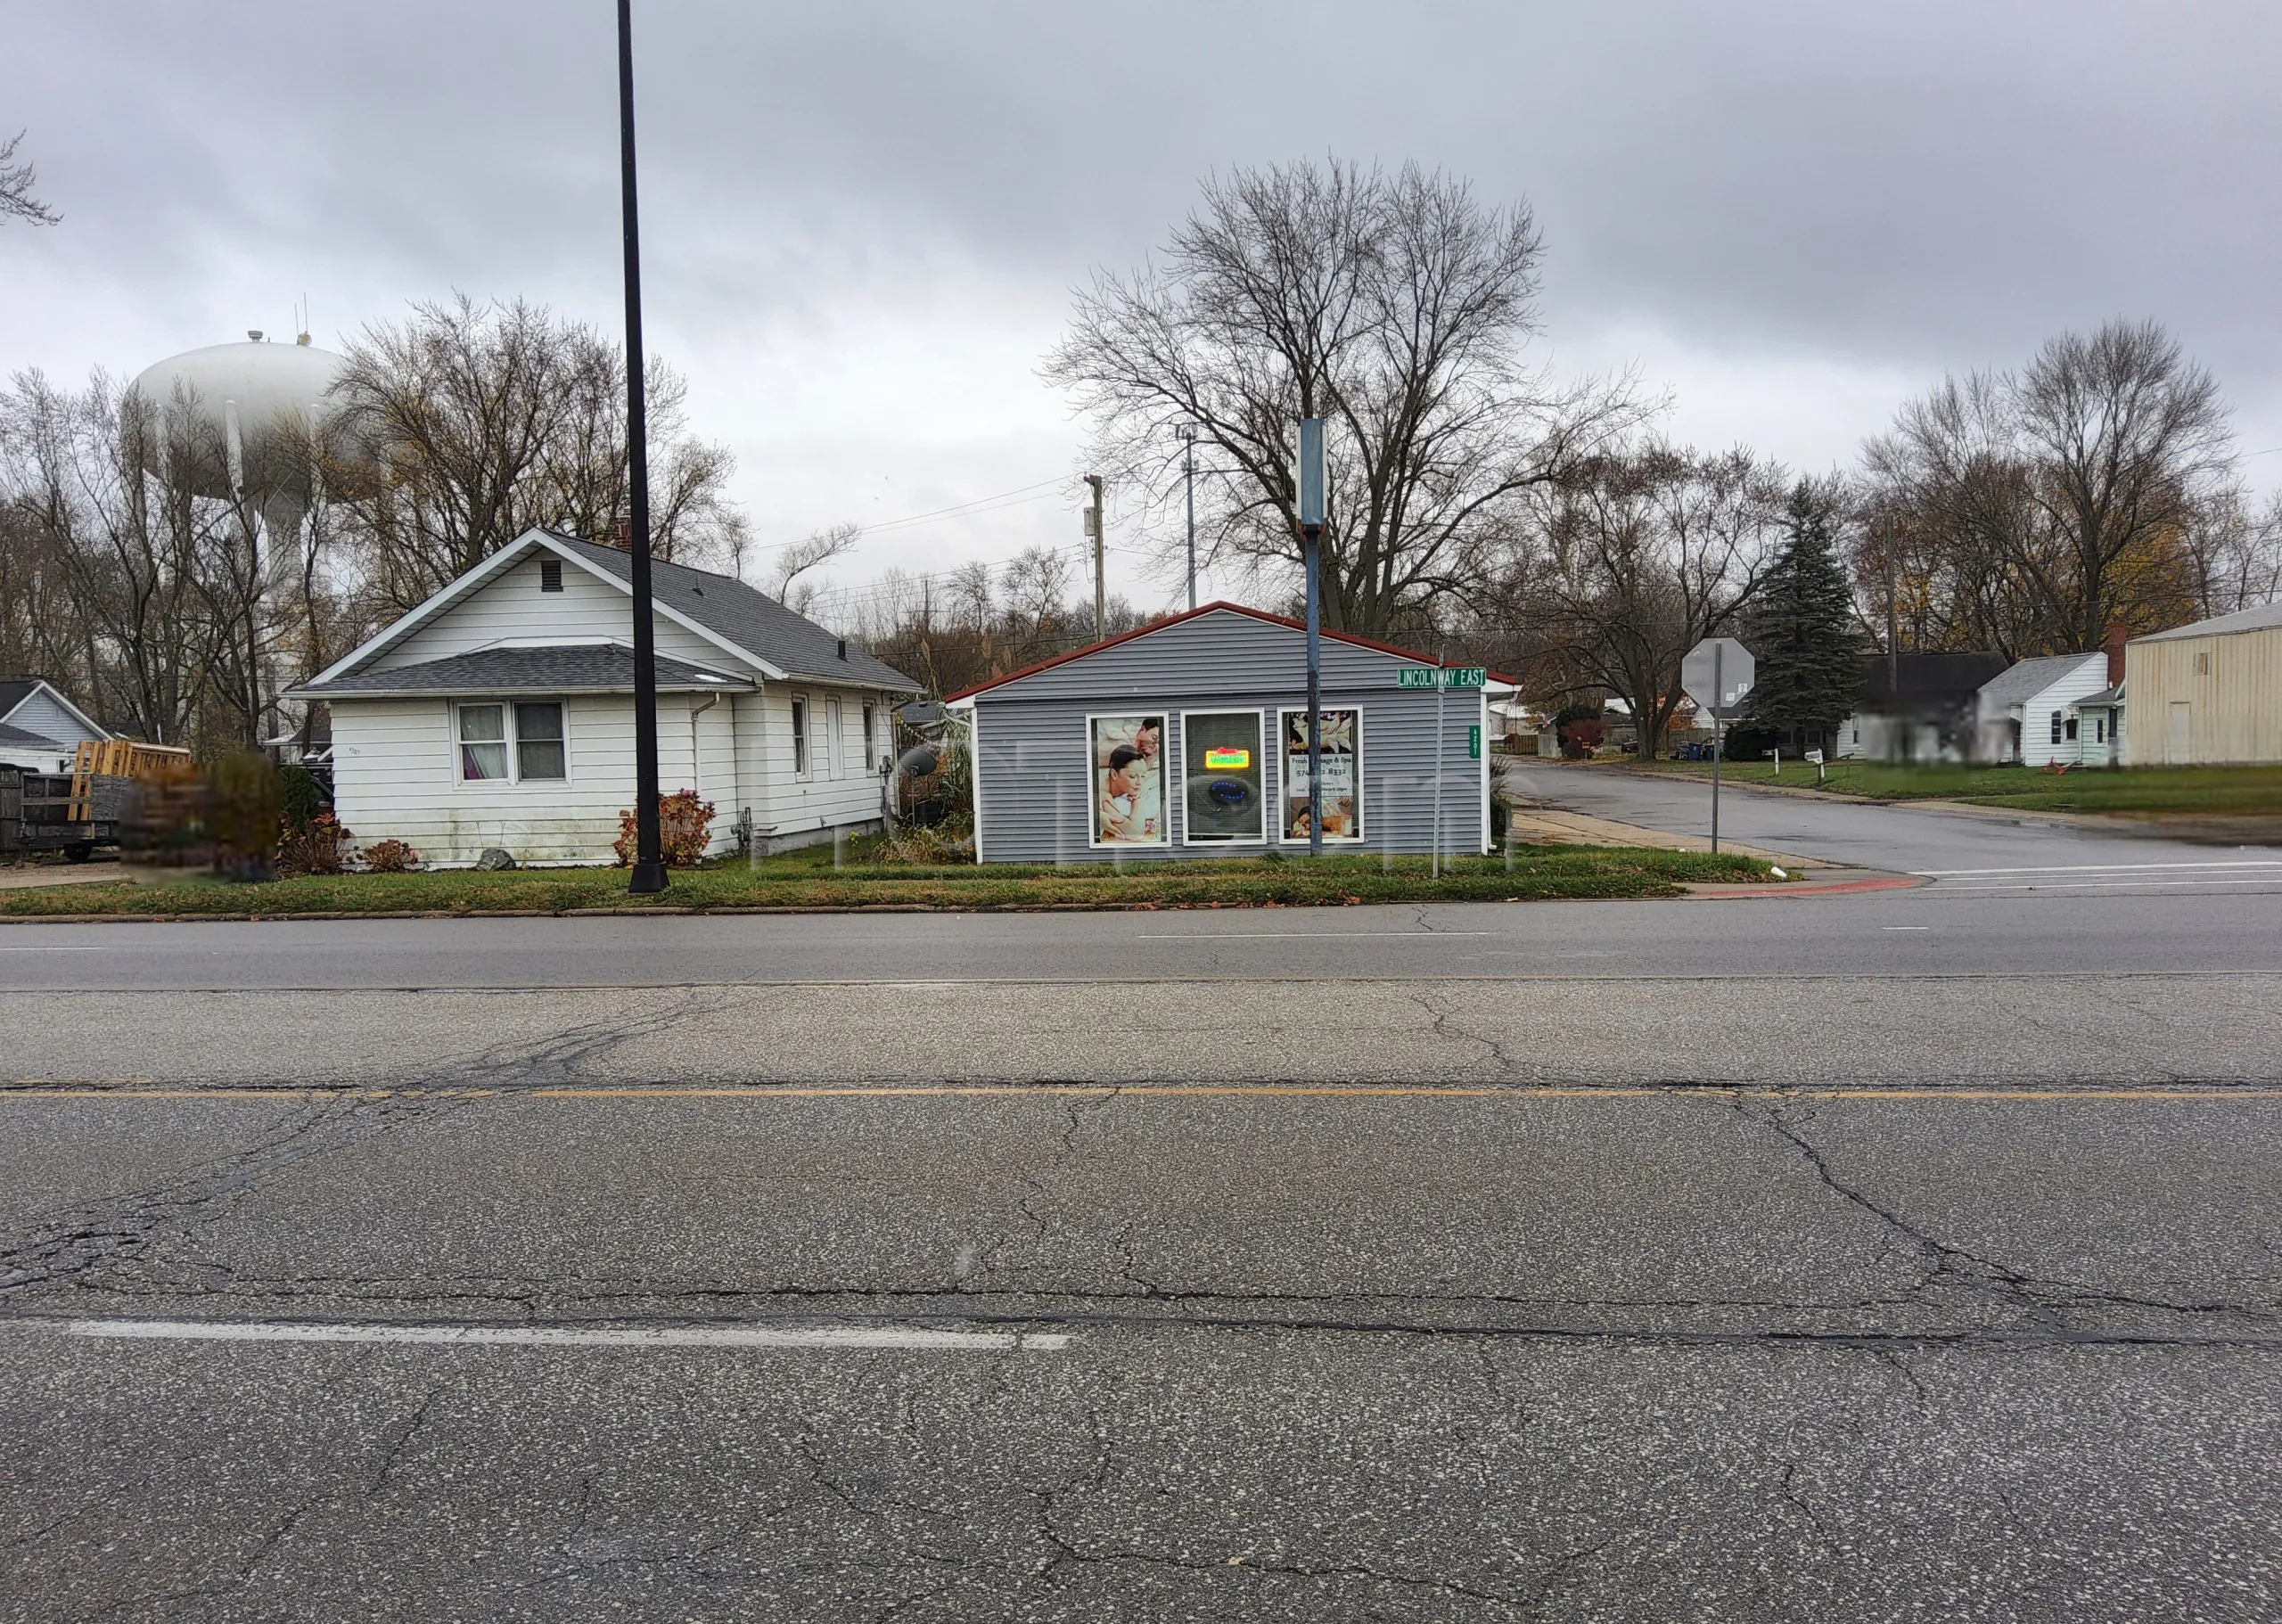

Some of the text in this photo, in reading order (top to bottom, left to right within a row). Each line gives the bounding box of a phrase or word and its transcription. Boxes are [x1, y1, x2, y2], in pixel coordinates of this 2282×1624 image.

[1399, 668, 1484, 685] LINCOLNWAY EAST
[1341, 757, 1352, 765] Spa
